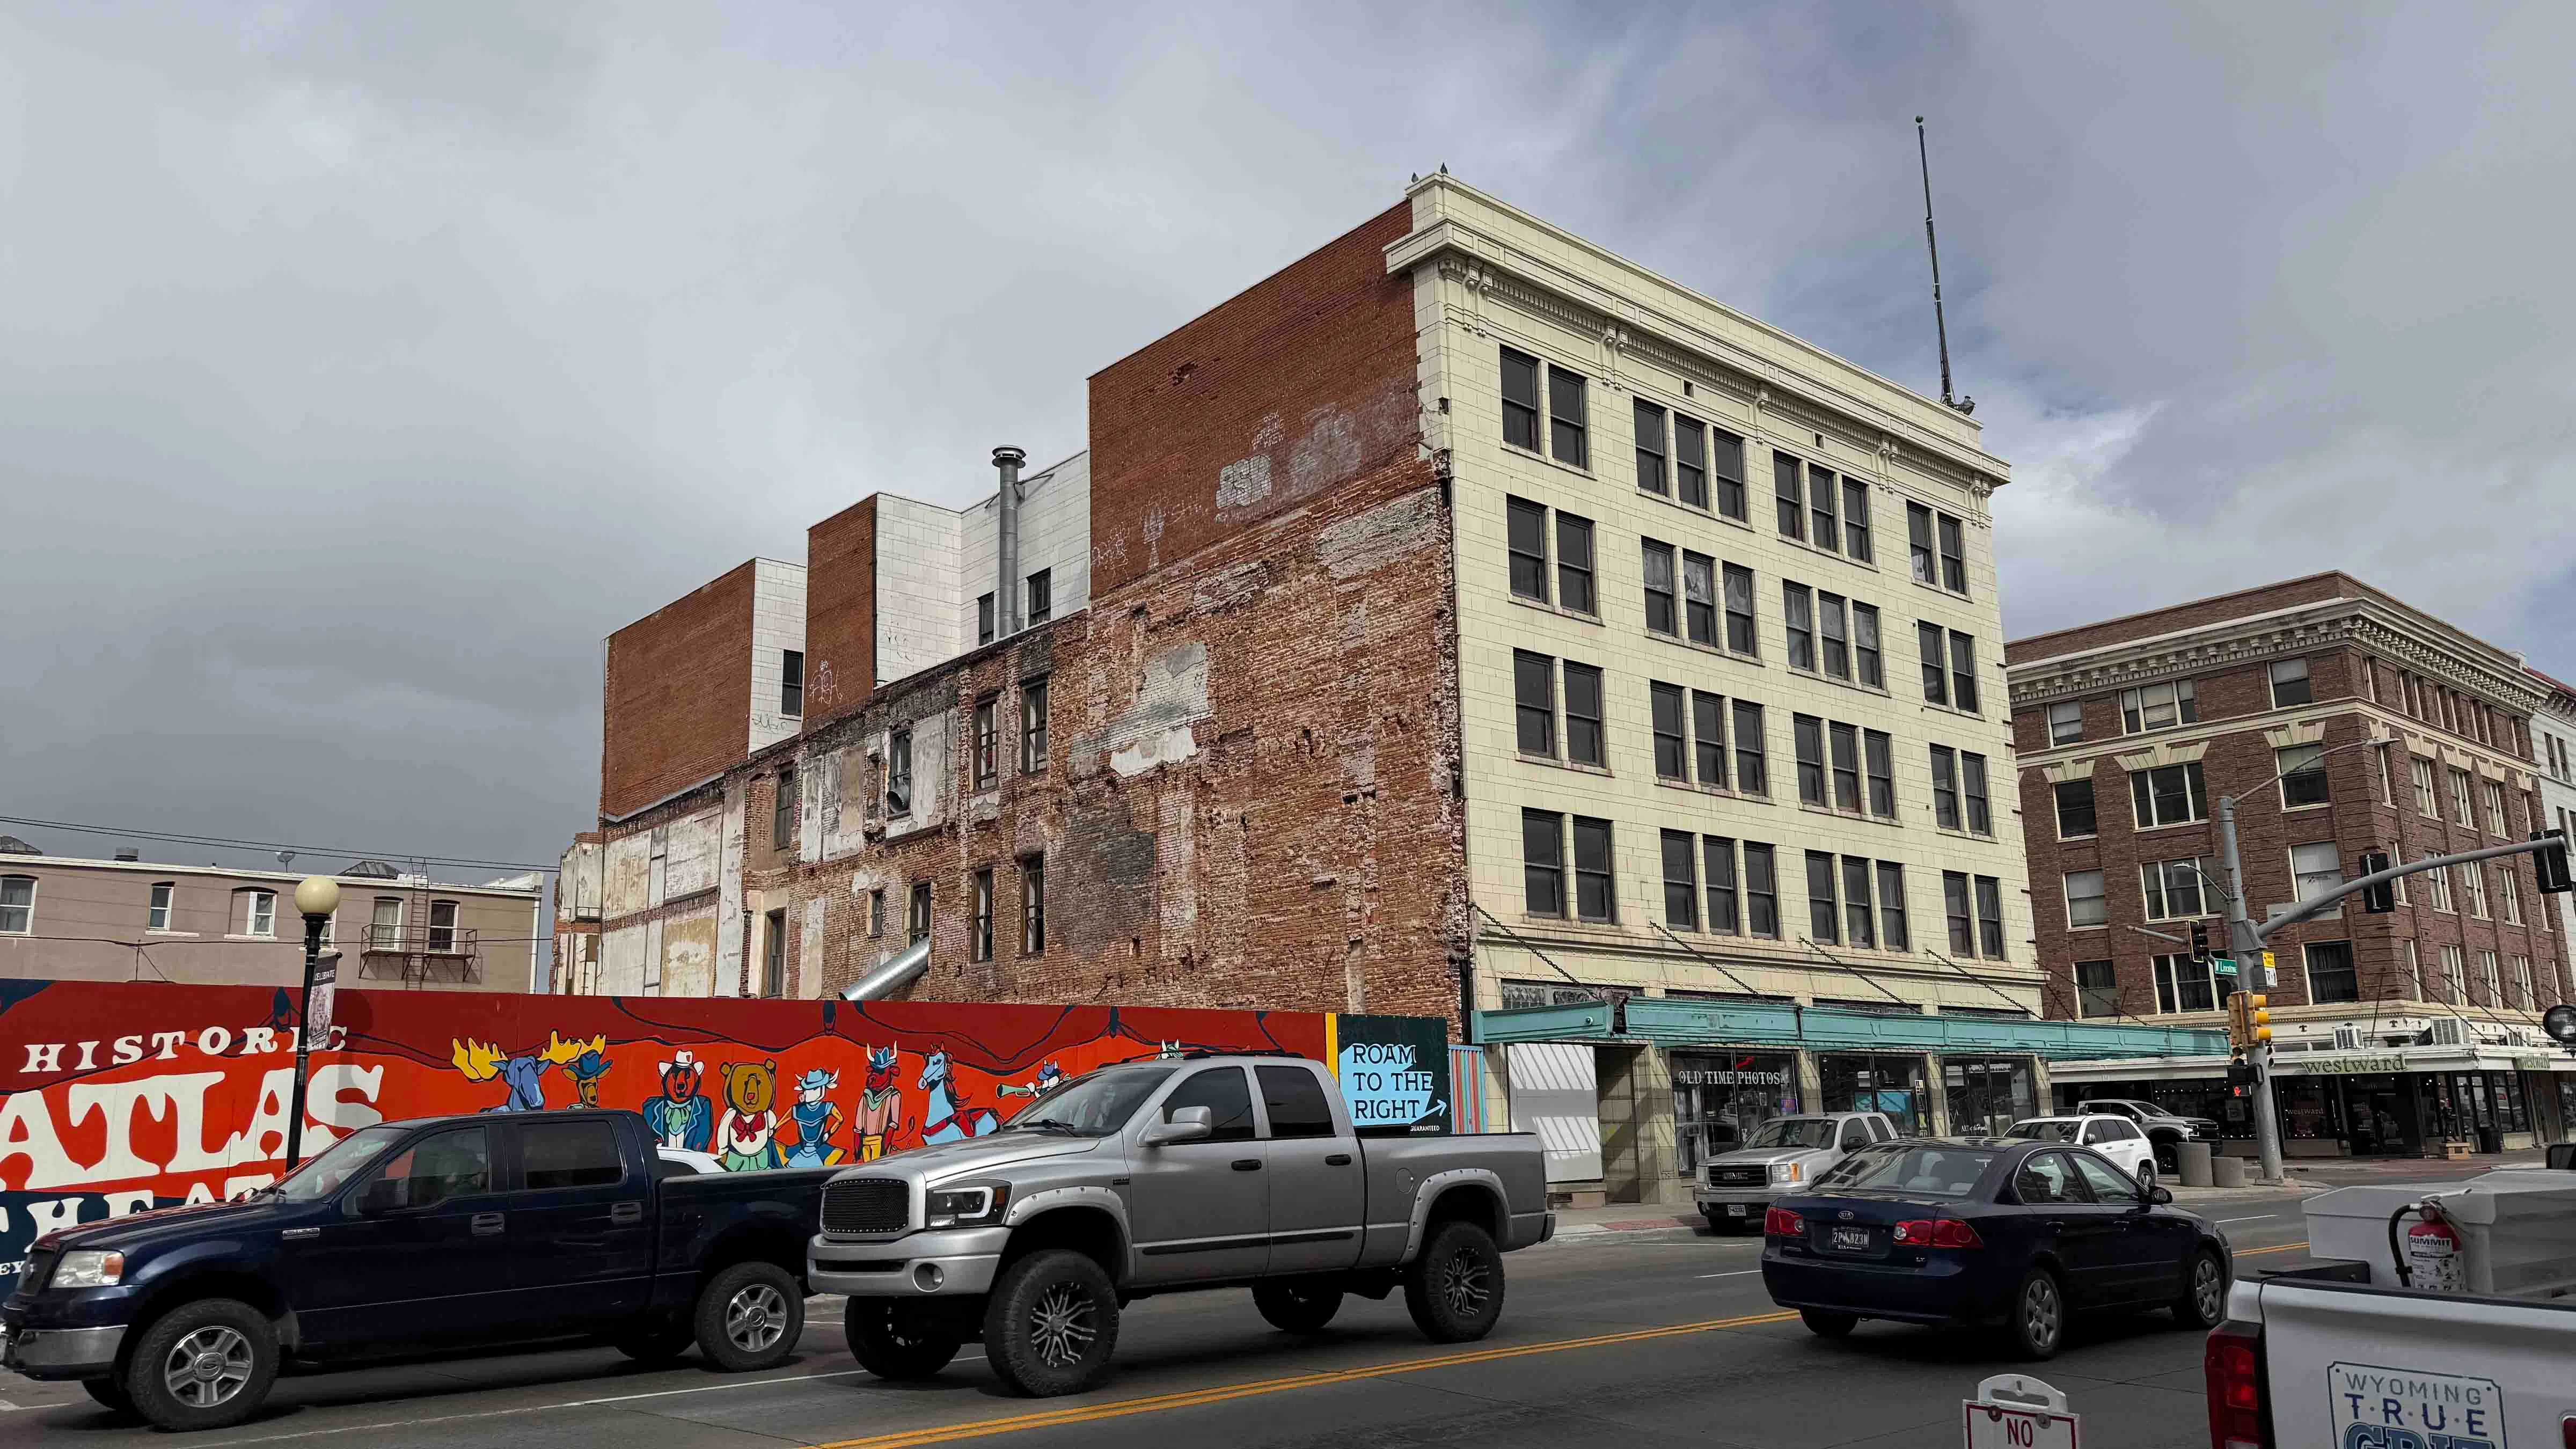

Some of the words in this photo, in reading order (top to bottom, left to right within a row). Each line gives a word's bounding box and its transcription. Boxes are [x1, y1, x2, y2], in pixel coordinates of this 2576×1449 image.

[1352, 1044, 1417, 1064] ROAM
[2302, 1052, 2408, 1073] westward
[1353, 1072, 1382, 1092] TO
[1391, 1072, 1432, 1092] THE
[1679, 1070, 1702, 1084] OLD
[1705, 1071, 1734, 1085] TIME
[1737, 1071, 1780, 1085] PHOTOS
[1355, 1100, 1420, 1119] RIGHT
[0, 1064, 384, 1190] ATLAS
[2410, 1236, 2450, 1246] SUMMIT
[2345, 1372, 2482, 1406] WYOMING
[2007, 1417, 2033, 1448] NO
